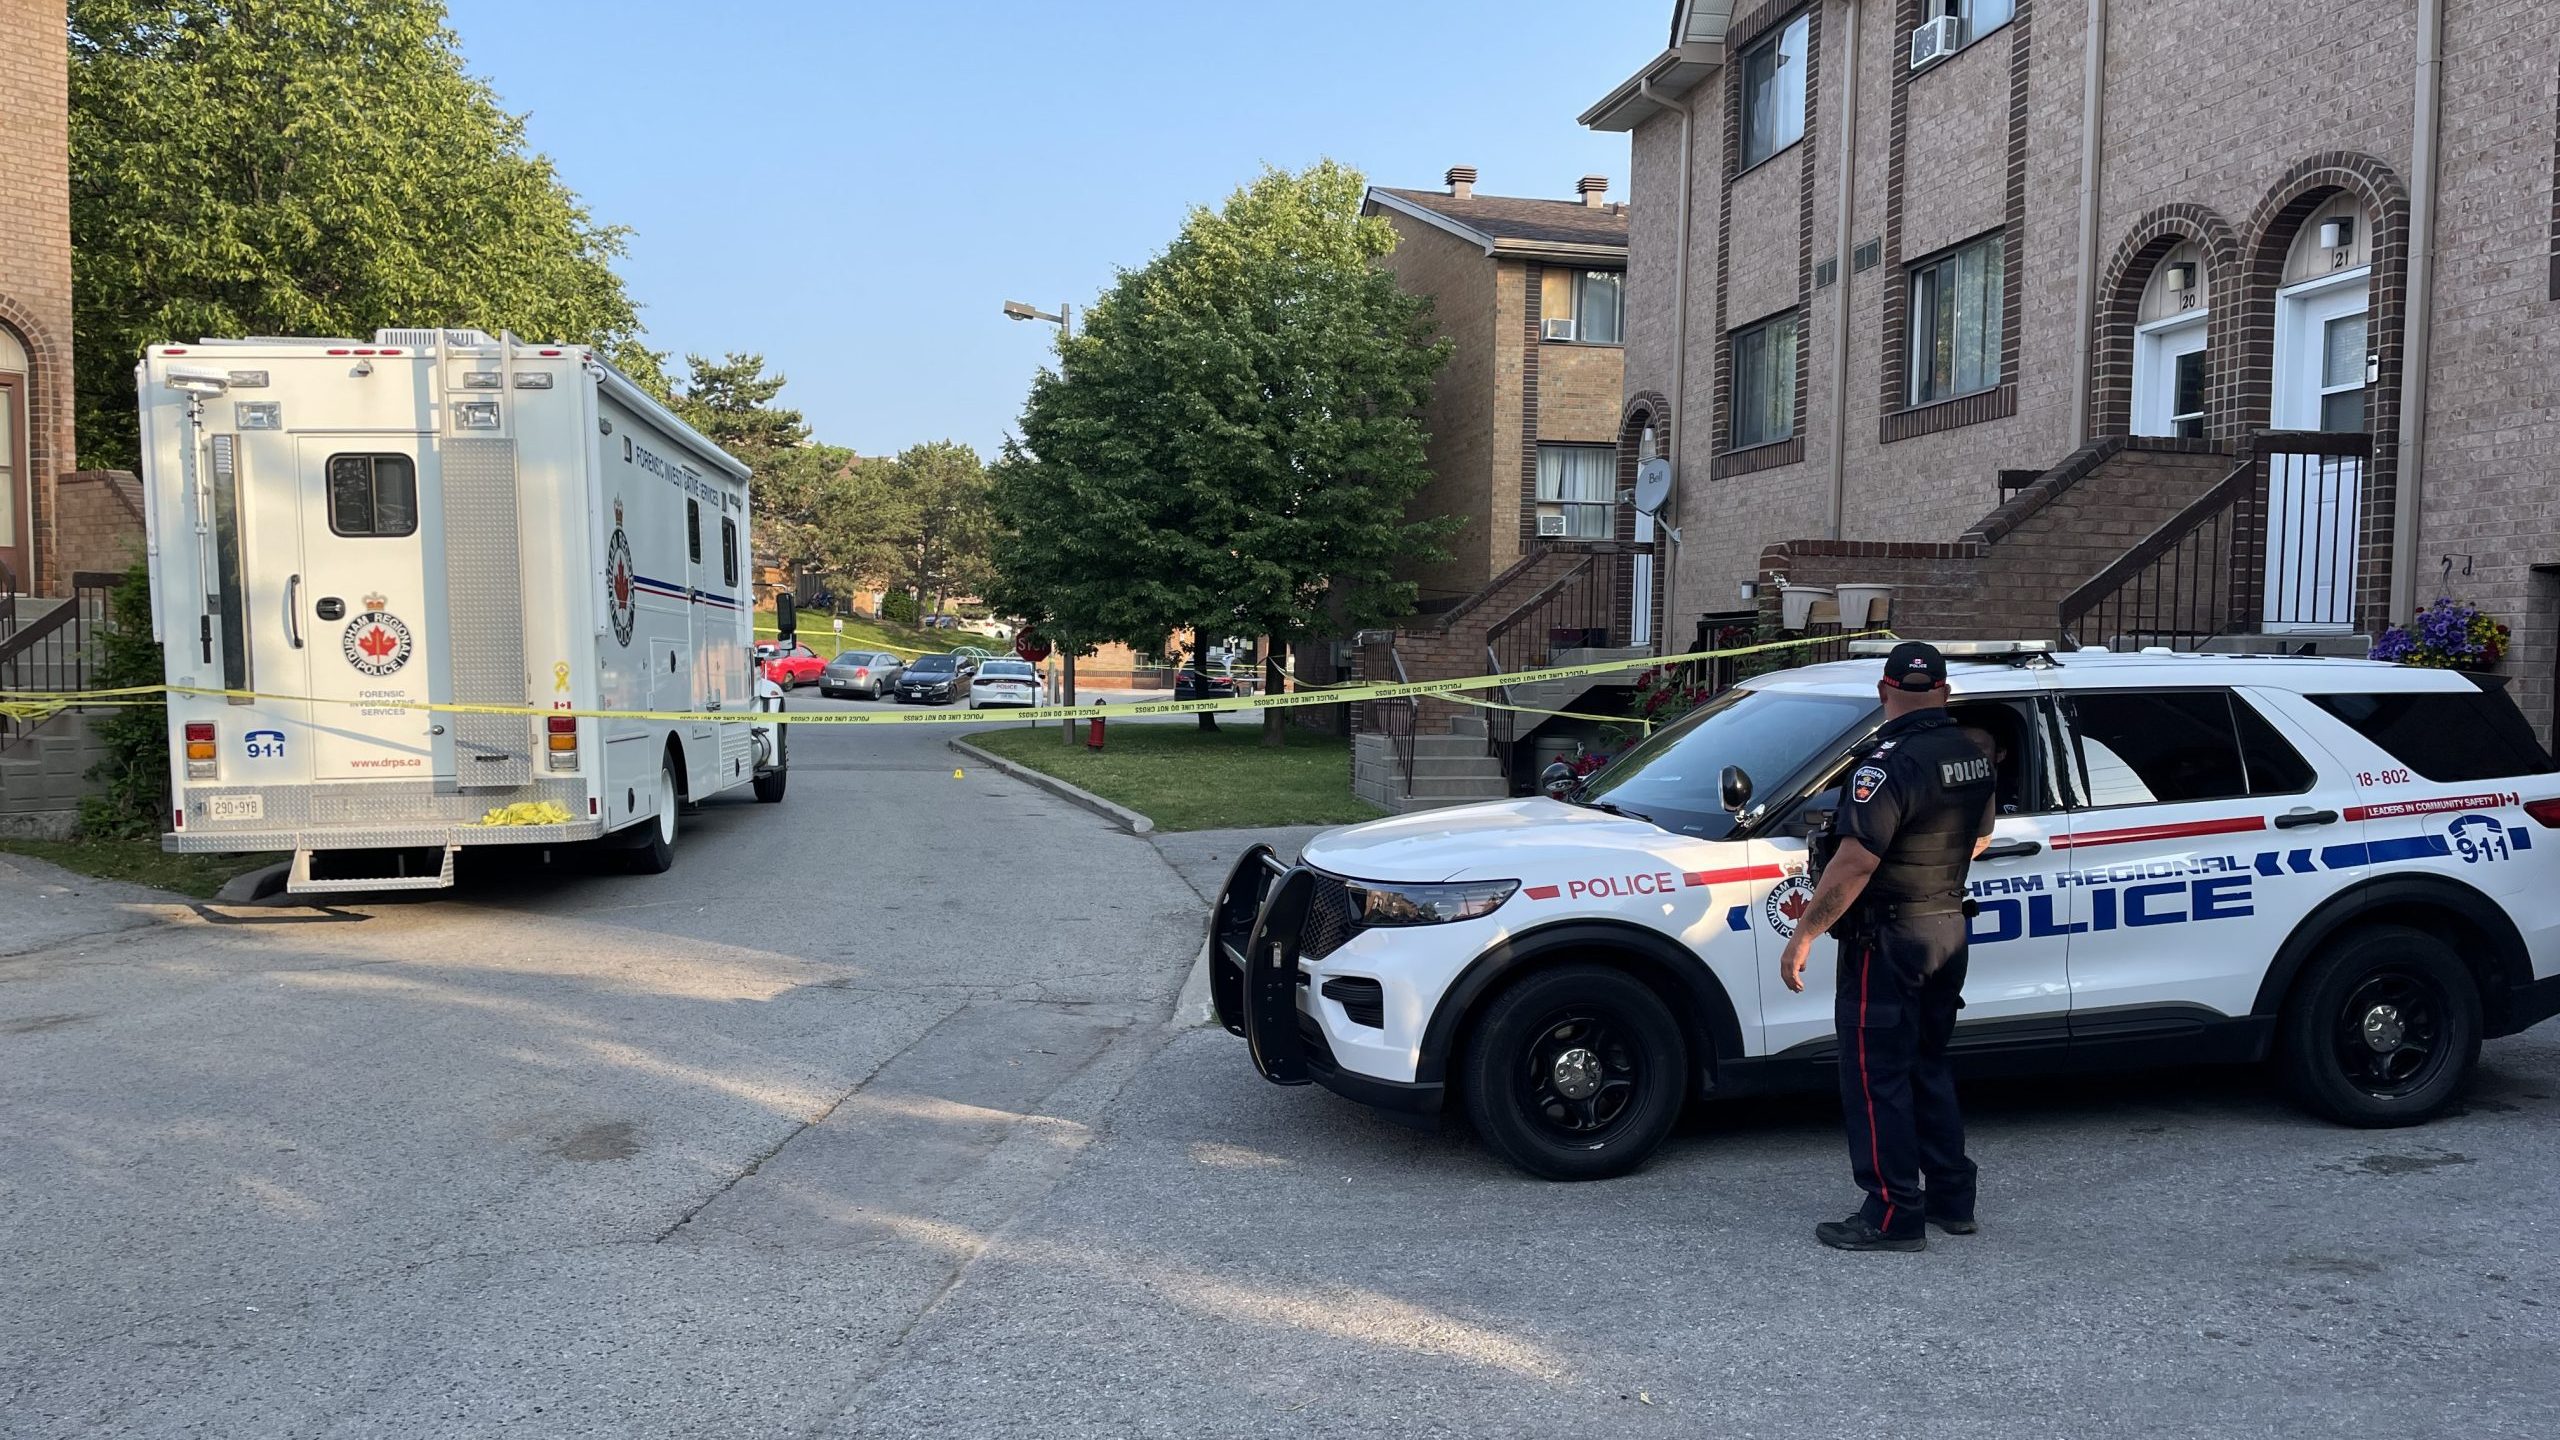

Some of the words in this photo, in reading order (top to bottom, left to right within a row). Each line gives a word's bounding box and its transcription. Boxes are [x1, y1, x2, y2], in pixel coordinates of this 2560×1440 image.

[2335, 250, 2349, 268] 21
[2182, 294, 2195, 310] 20
[636, 446, 664, 479] FORENSIC
[1648, 471, 1663, 484] Bell
[344, 615, 370, 661] DURHAM
[373, 613, 411, 657] REGIONAL
[356, 660, 400, 676] POLICE
[359, 690, 405, 698] FORENSIC
[1276, 697, 1288, 705] NOT
[1376, 689, 1396, 697] CROSS
[361, 708, 406, 716] SERVICES
[1196, 702, 1218, 710] POLICE
[247, 743, 284, 758] 9-1-1
[351, 758, 421, 768] www.drps.ca
[1942, 757, 1991, 784] POLICE
[2356, 769, 2410, 787] 18-802
[2368, 804, 2405, 817] LEADERS
[2406, 803, 2415, 813] IN
[2416, 799, 2464, 812] COMMUNITY
[2465, 796, 2494, 806] SAFETY
[2456, 835, 2509, 864] 9-1-1
[1967, 875, 2044, 897] HAM
[2056, 855, 2251, 888] REGIONAL
[1568, 872, 1676, 899] POLICE
[1767, 881, 1790, 927] DURHAM
[1966, 874, 2255, 945] OLICE
